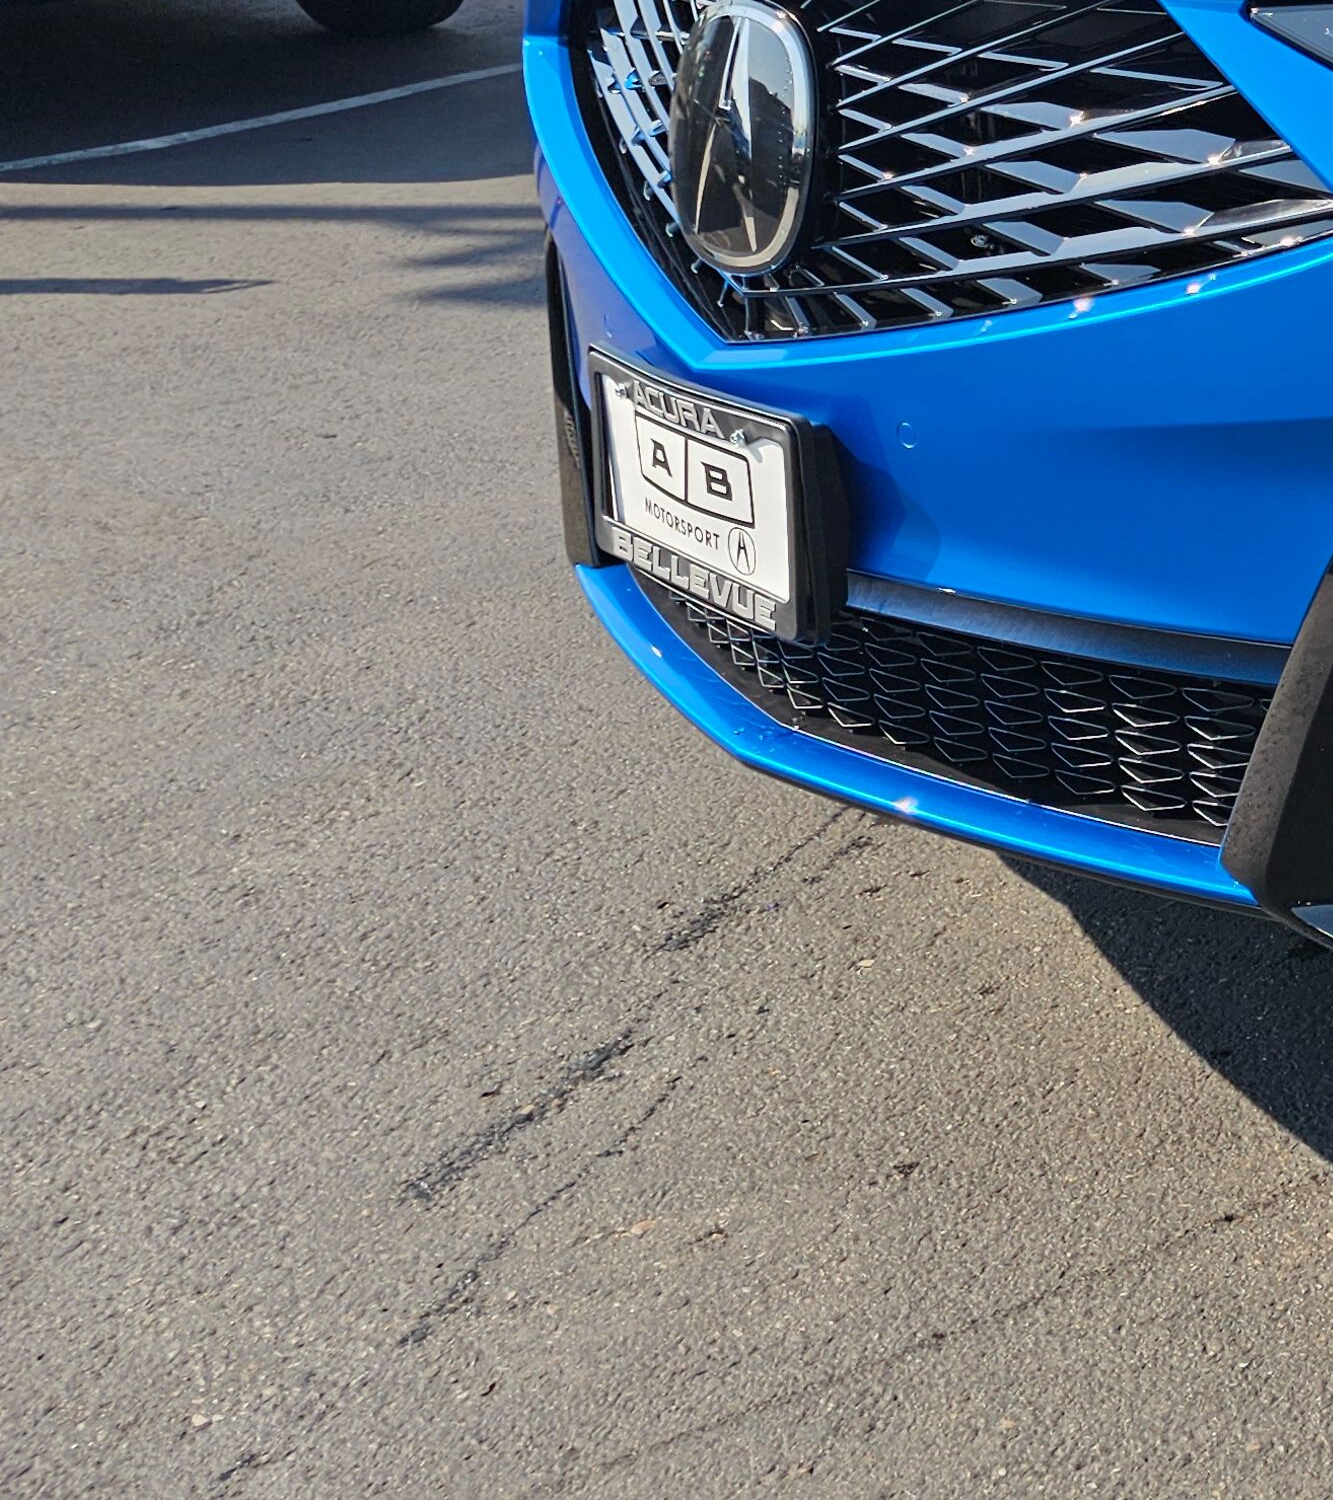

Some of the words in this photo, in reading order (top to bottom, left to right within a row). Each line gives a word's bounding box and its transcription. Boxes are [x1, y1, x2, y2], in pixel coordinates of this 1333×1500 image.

[632, 380, 725, 439] ACURA
[645, 498, 720, 550] MOTORSPORT
[611, 526, 777, 631] BELLEVUE
